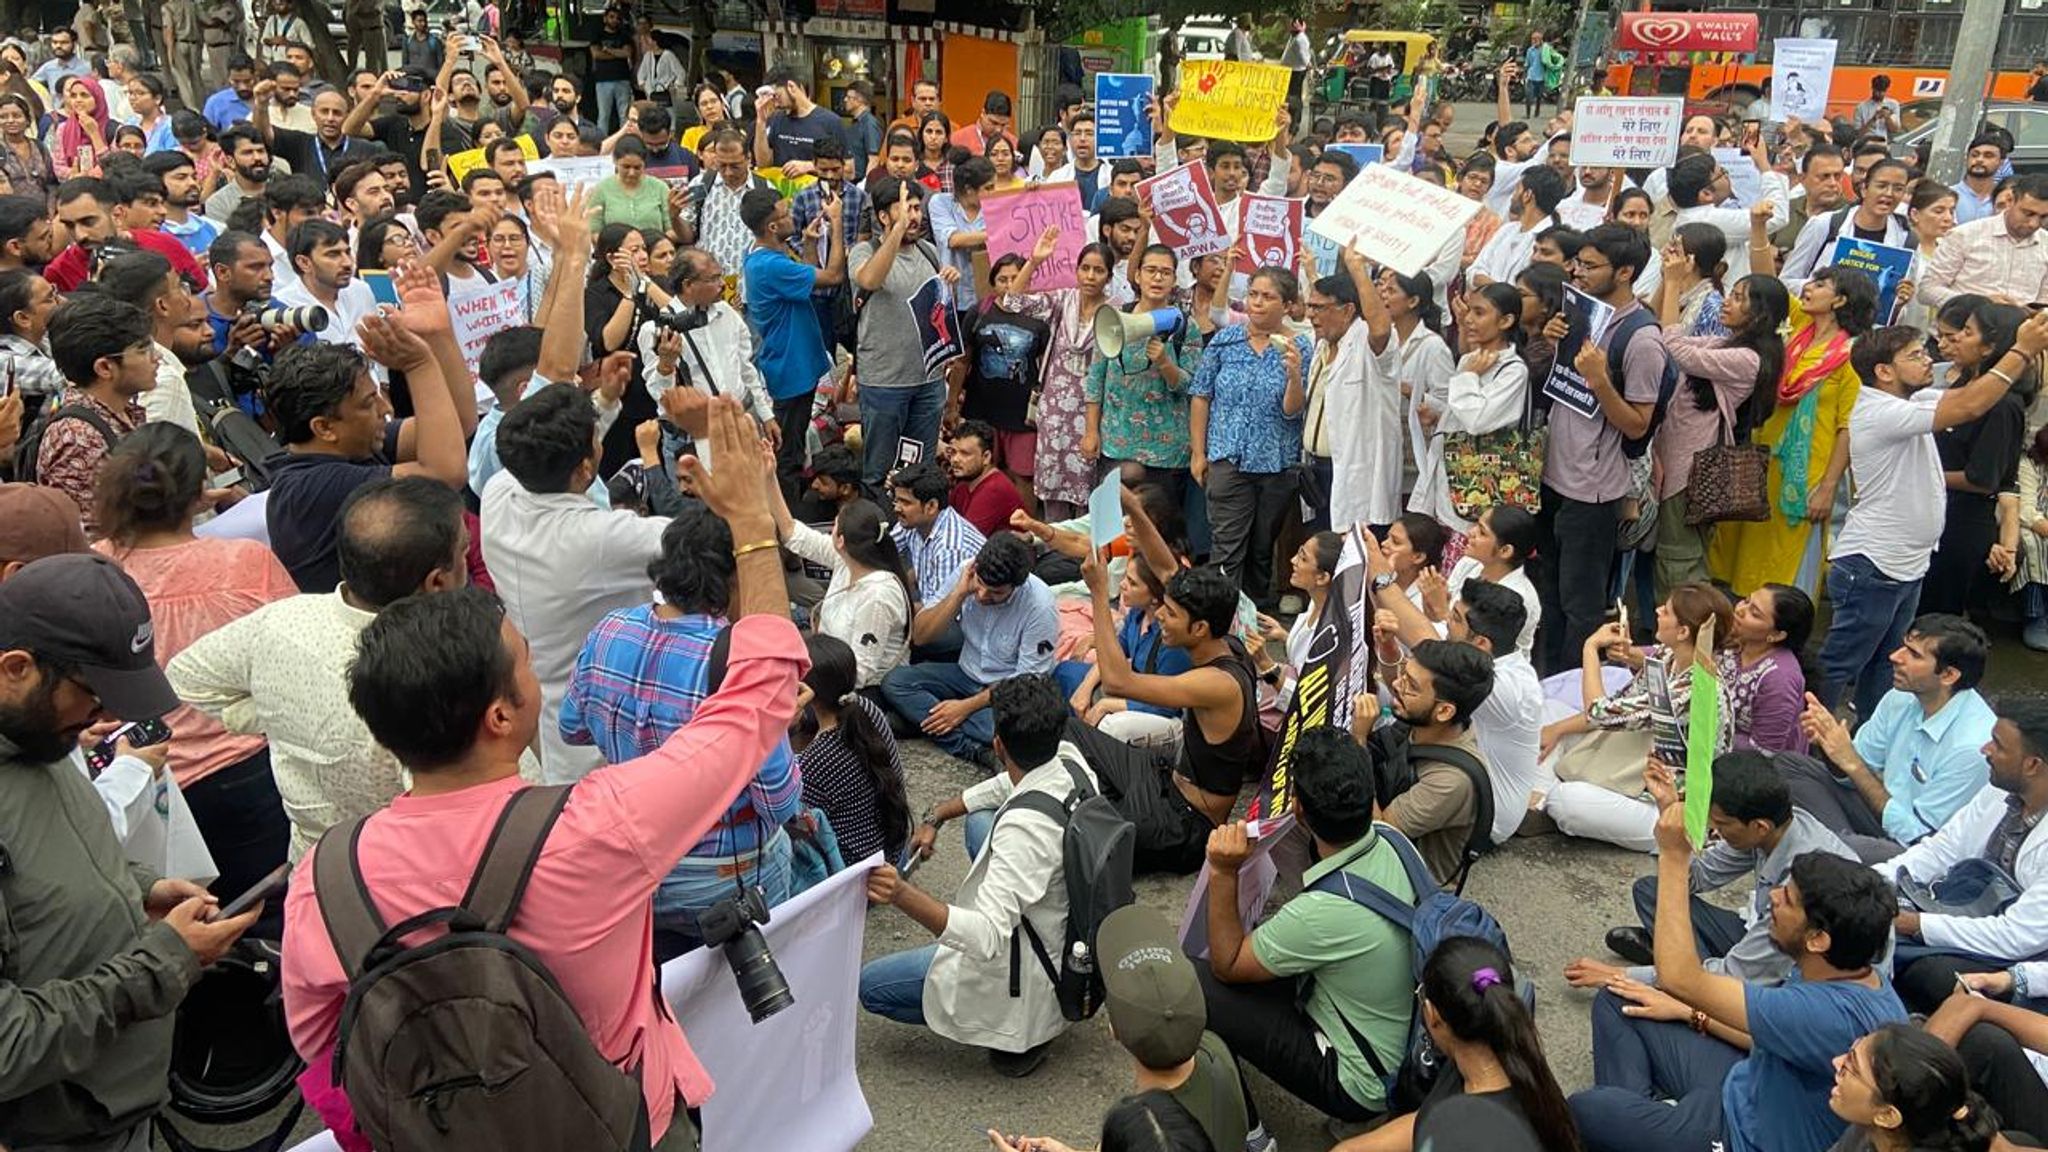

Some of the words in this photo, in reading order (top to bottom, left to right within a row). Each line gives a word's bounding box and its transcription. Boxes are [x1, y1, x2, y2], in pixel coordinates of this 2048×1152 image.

[1696, 21, 1749, 31] KWALITY
[1701, 31, 1742, 42] WALL'S
[1010, 201, 1080, 242] STRIKE
[1180, 241, 1219, 260] AIPWA
[455, 294, 498, 317] WHEN
